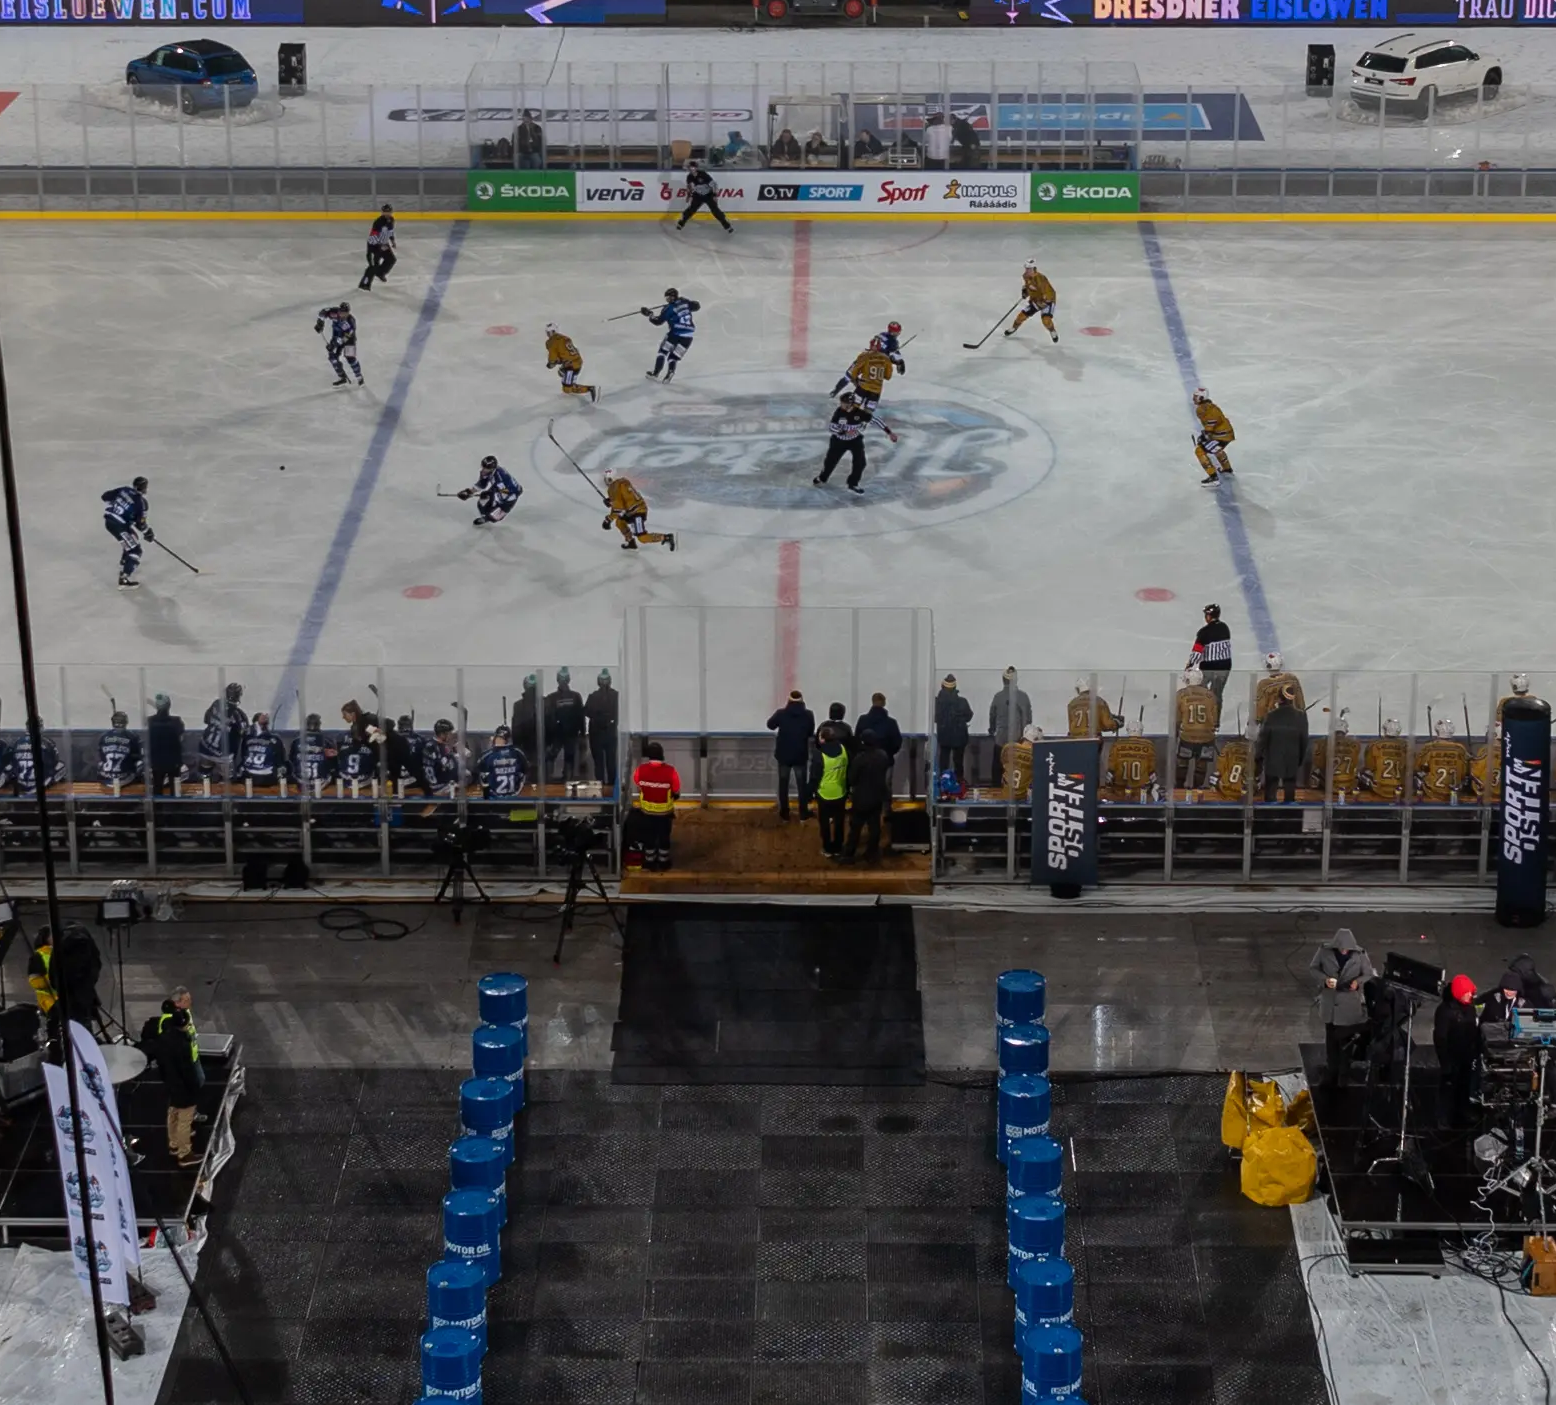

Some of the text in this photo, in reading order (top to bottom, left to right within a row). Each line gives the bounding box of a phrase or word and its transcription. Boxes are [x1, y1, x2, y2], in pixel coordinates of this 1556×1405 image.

[500, 183, 570, 198] ŠKODA
[585, 186, 645, 202] verva
[809, 186, 853, 199] SPORT
[877, 180, 930, 205] Sport
[961, 185, 1017, 198] IMPULS
[1062, 184, 1132, 199] ŠKODA
[869, 365, 885, 380] 90
[1188, 704, 1206, 723] 15
[347, 754, 360, 773] 9
[1123, 761, 1141, 780] 10
[496, 775, 516, 794] 21
[1503, 765, 1522, 864] SPORT
[1519, 760, 1542, 851] OSTEN
[1064, 774, 1085, 858] OSTEN
[1047, 783, 1068, 870] SPORT
[445, 1240, 491, 1254] MOTOR OIL
